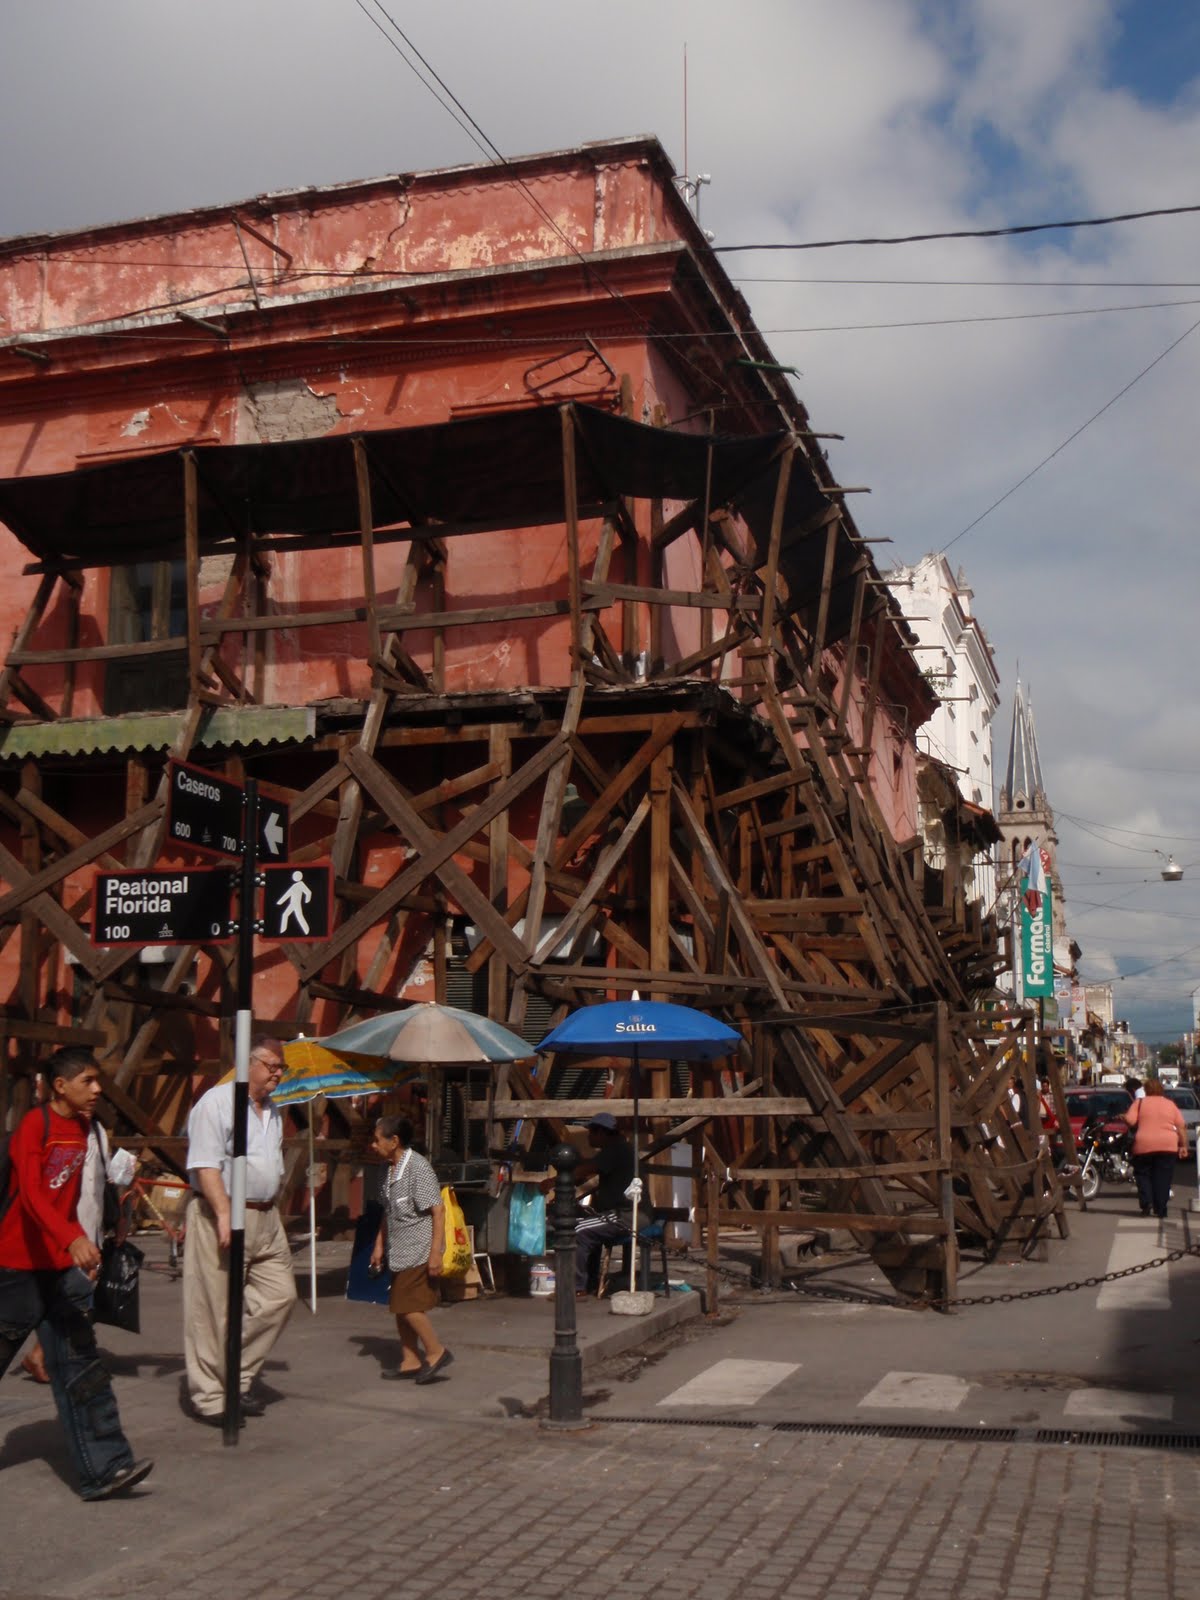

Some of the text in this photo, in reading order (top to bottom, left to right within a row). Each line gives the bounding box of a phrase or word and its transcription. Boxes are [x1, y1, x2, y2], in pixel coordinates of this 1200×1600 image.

[177, 771, 221, 802] Caseros
[175, 821, 237, 852] 600 700
[106, 876, 188, 896] Peatonal
[105, 895, 171, 915] Florida
[104, 922, 221, 939] 100 0
[615, 1022, 656, 1033] Salta
